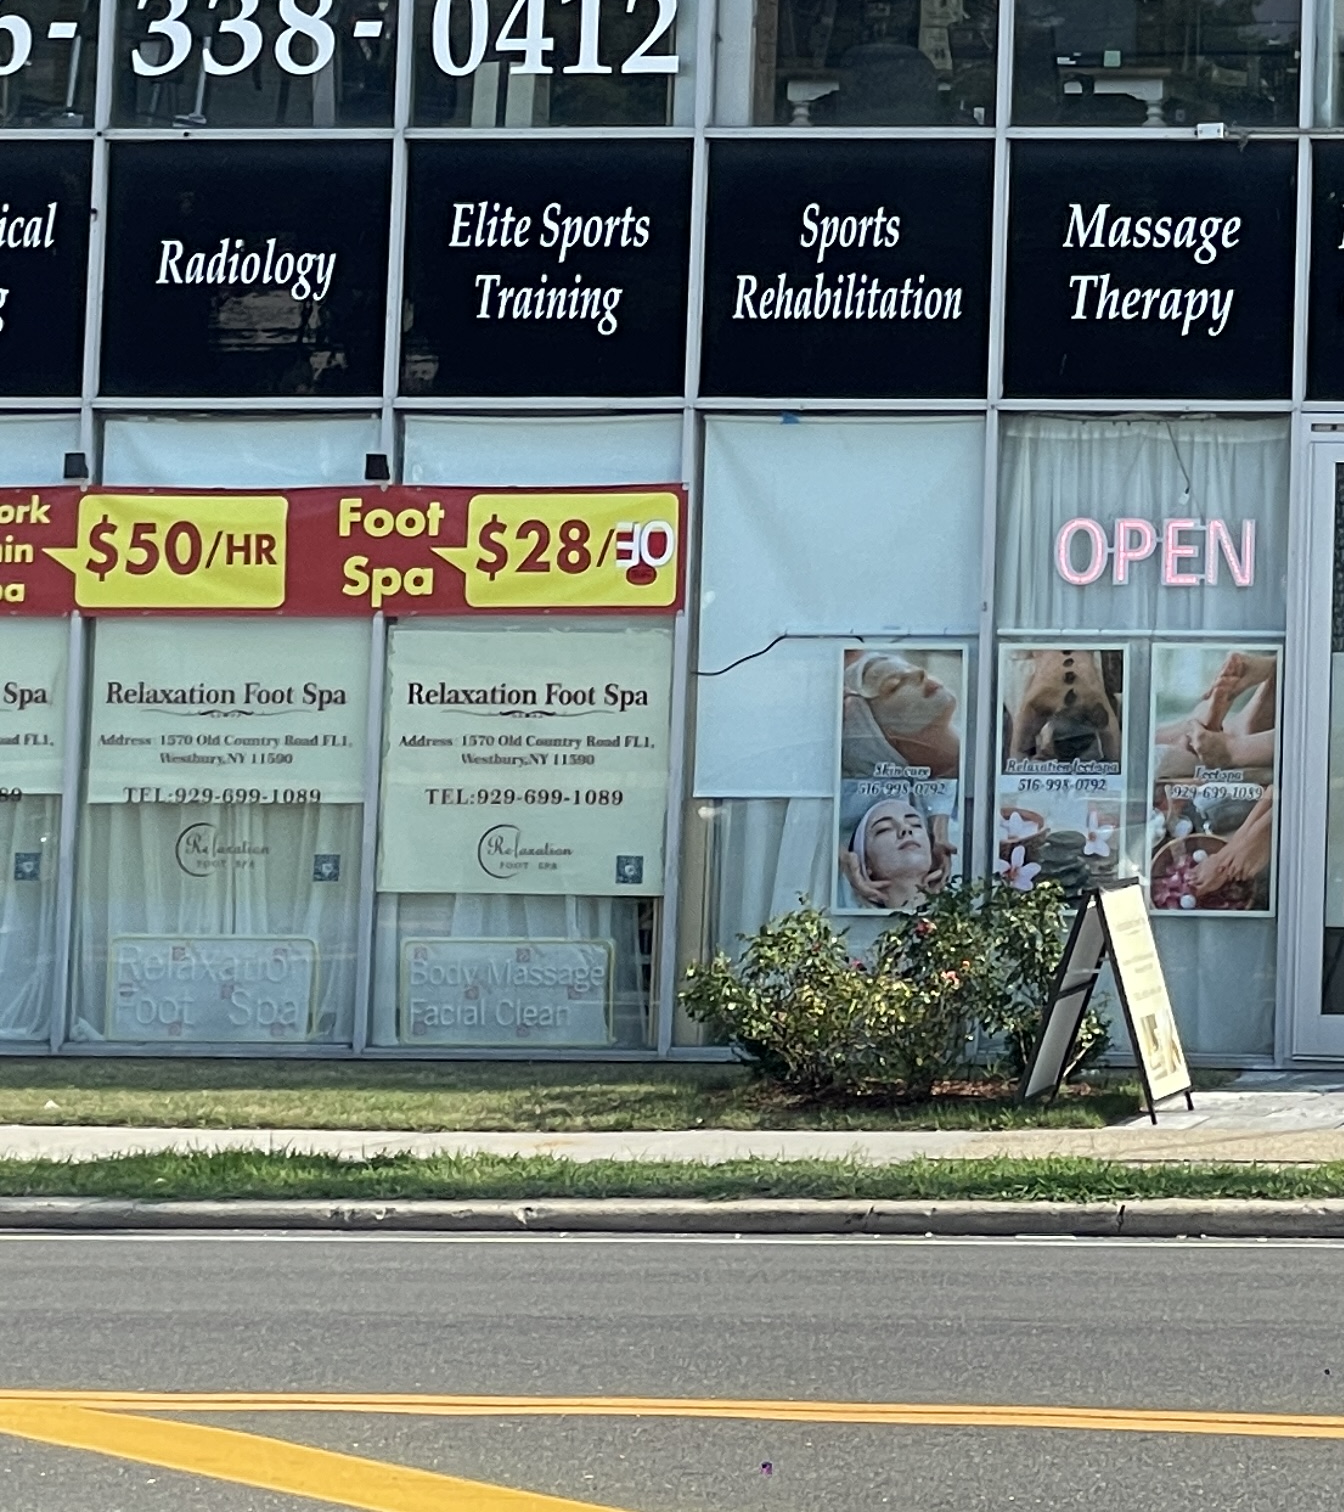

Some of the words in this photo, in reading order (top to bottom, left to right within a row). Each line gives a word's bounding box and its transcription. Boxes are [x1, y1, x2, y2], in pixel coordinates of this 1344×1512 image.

[448, 202, 532, 249] Elite
[538, 202, 651, 263] Sports
[800, 202, 901, 263] Sports
[1062, 202, 1242, 265] Massage
[156, 238, 337, 301] Radiology
[474, 273, 624, 336] Training
[732, 273, 963, 321] Rehabilitation
[1069, 273, 1235, 337] Therapy
[338, 497, 445, 539] Foot
[86, 514, 278, 582] $50/HR
[1055, 518, 1256, 586] OPEN
[341, 557, 435, 608] Spa
[3, 681, 50, 711] Spa
[106, 681, 236, 705] Relaxation
[243, 682, 295, 705] Foot
[302, 682, 347, 711] Spa
[407, 682, 537, 706] Relaxation
[545, 683, 597, 706] Foot
[604, 683, 649, 712] Spa
[160, 734, 193, 746] 1570
[197, 734, 222, 746] Old
[224, 735, 280, 749] Country
[284, 735, 319, 747] Road
[462, 735, 495, 747] 1570
[498, 735, 522, 747] Old
[525, 735, 582, 750] Country
[586, 735, 621, 748] Road
[425, 788, 624, 806] TEL:929-699-1089
[486, 832, 573, 859] Relaxation
[410, 958, 478, 989] Body
[487, 958, 605, 993] Massage
[115, 987, 196, 1026] Foot
[227, 989, 299, 1028] Spa
[410, 998, 486, 1028] Facial
[495, 998, 571, 1028] Clean
